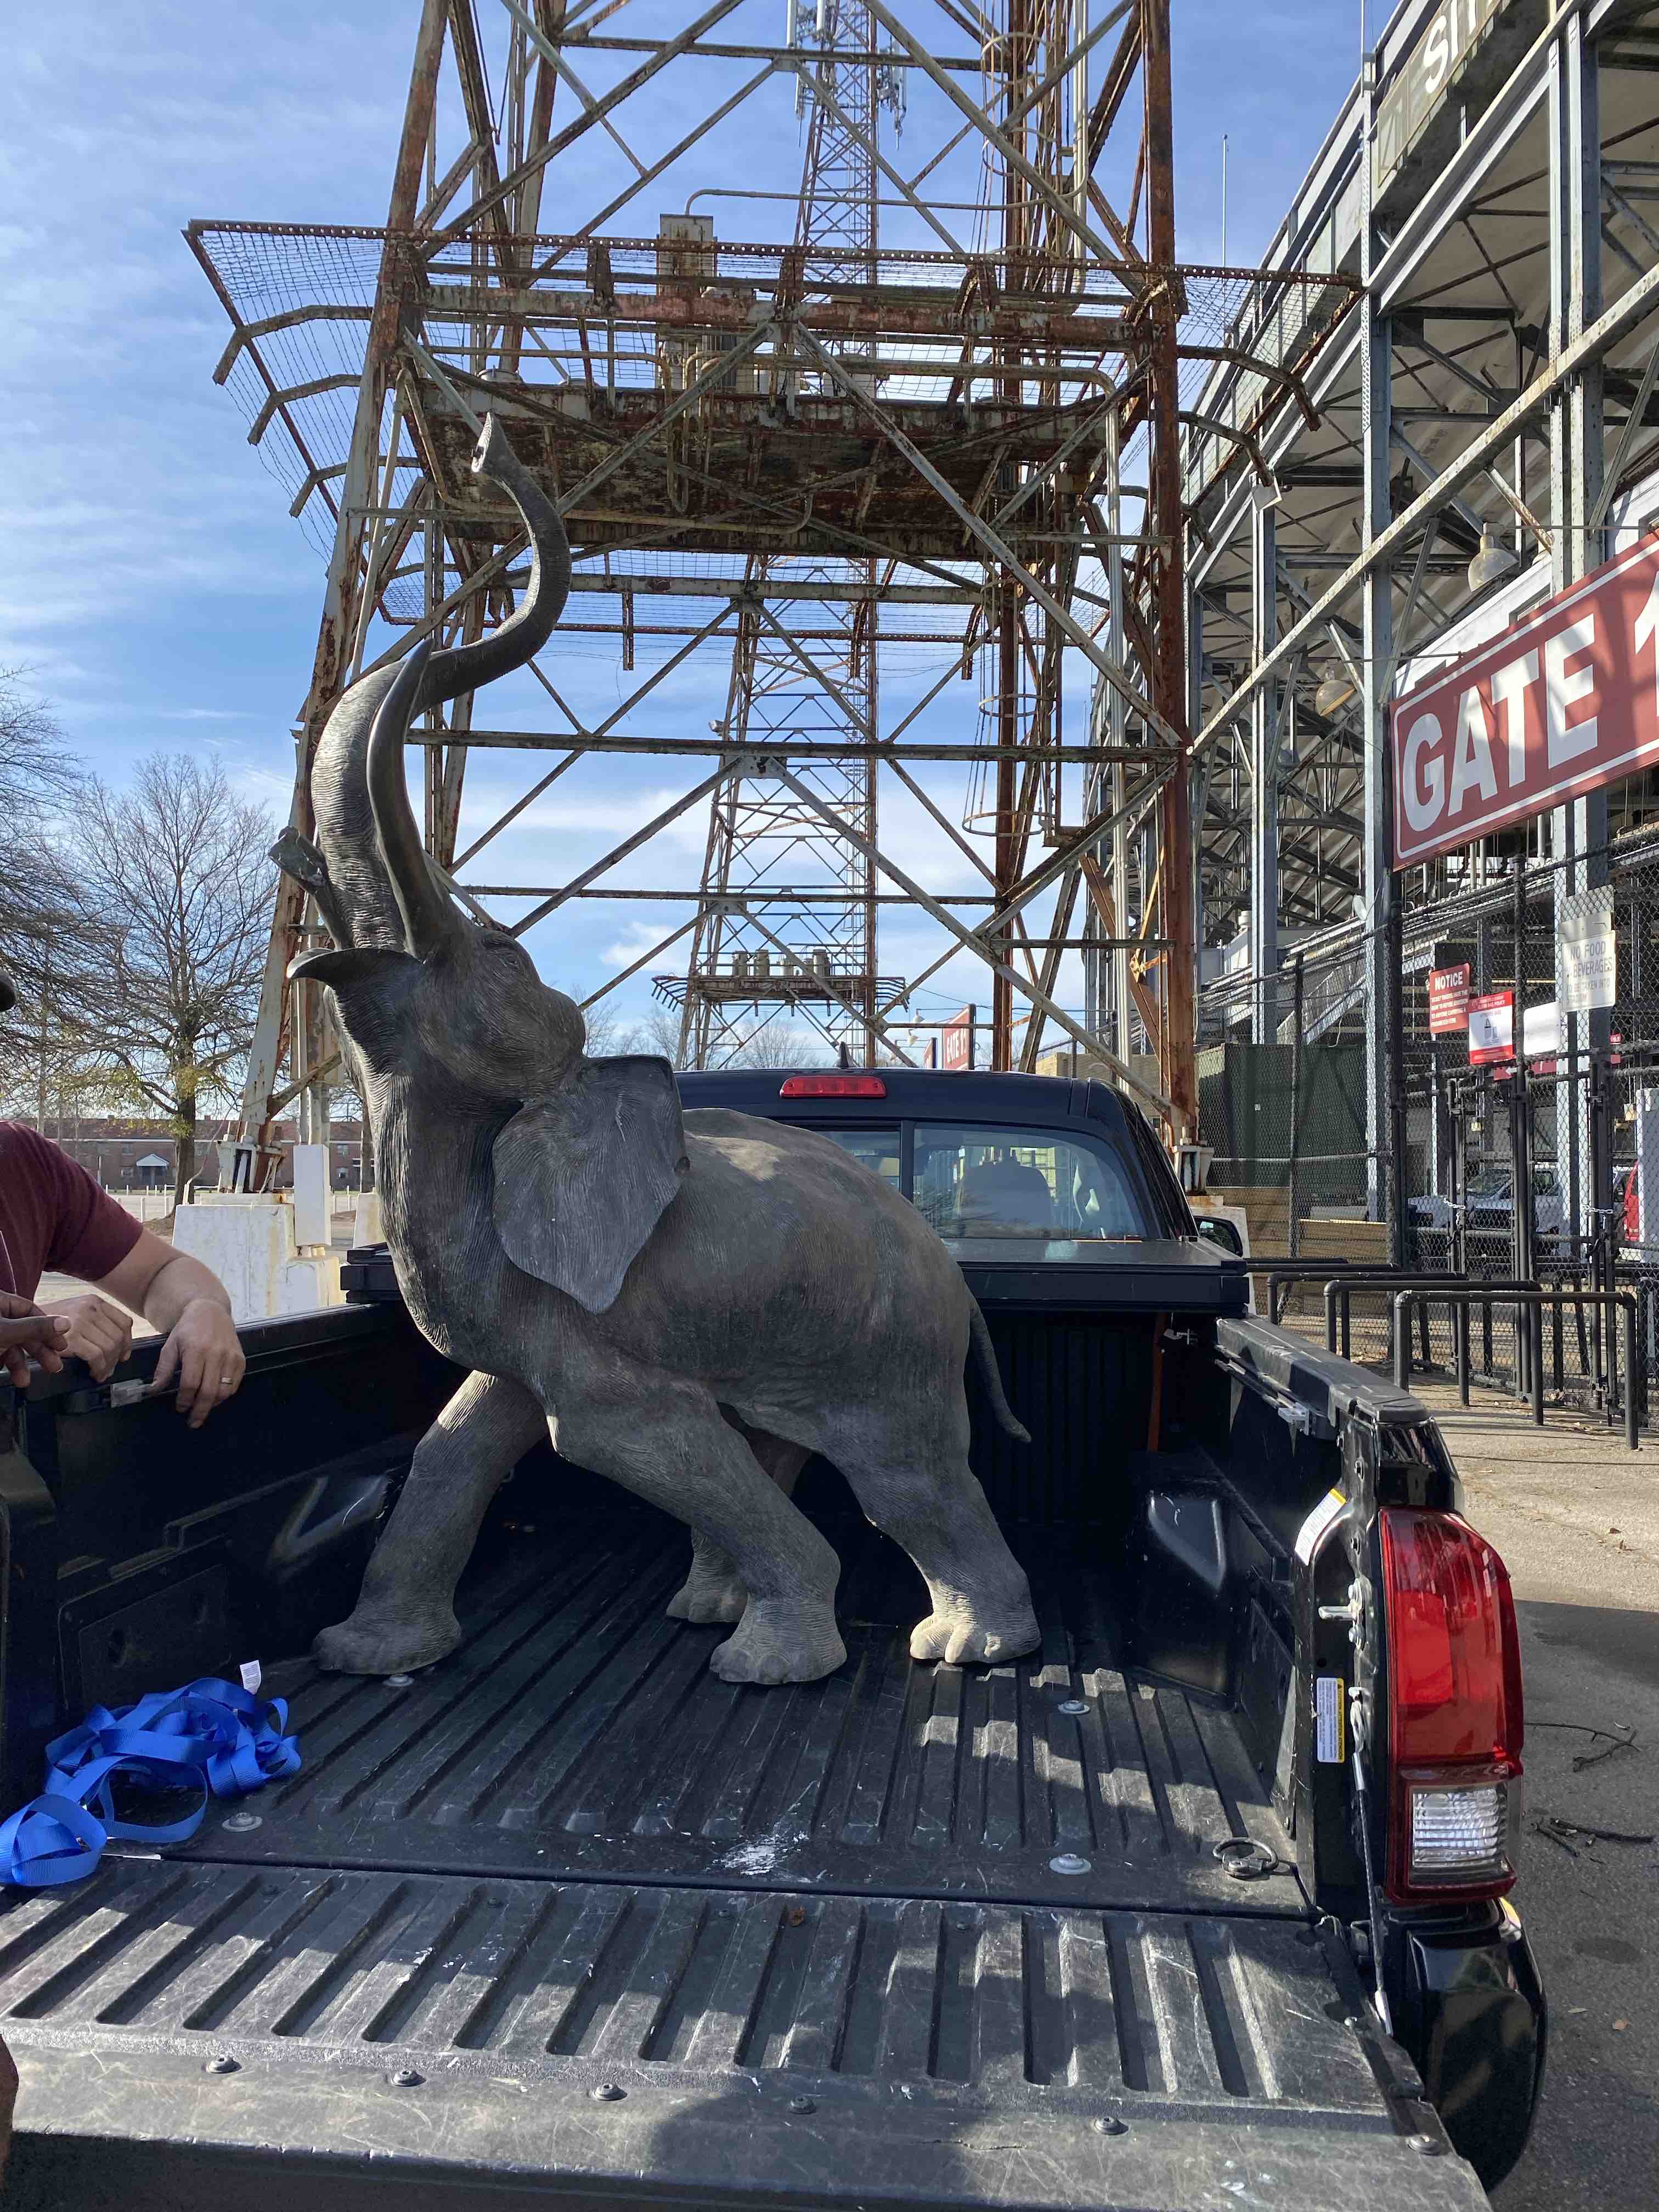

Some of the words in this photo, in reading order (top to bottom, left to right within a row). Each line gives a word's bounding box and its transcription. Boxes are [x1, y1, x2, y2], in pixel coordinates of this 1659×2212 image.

[1402, 613, 1598, 832] GATE
[1571, 946, 1581, 960] NO
[1584, 940, 1606, 957] FOOD
[1573, 956, 1613, 977] BEVERAGES
[1435, 970, 1463, 991] NOTICE
